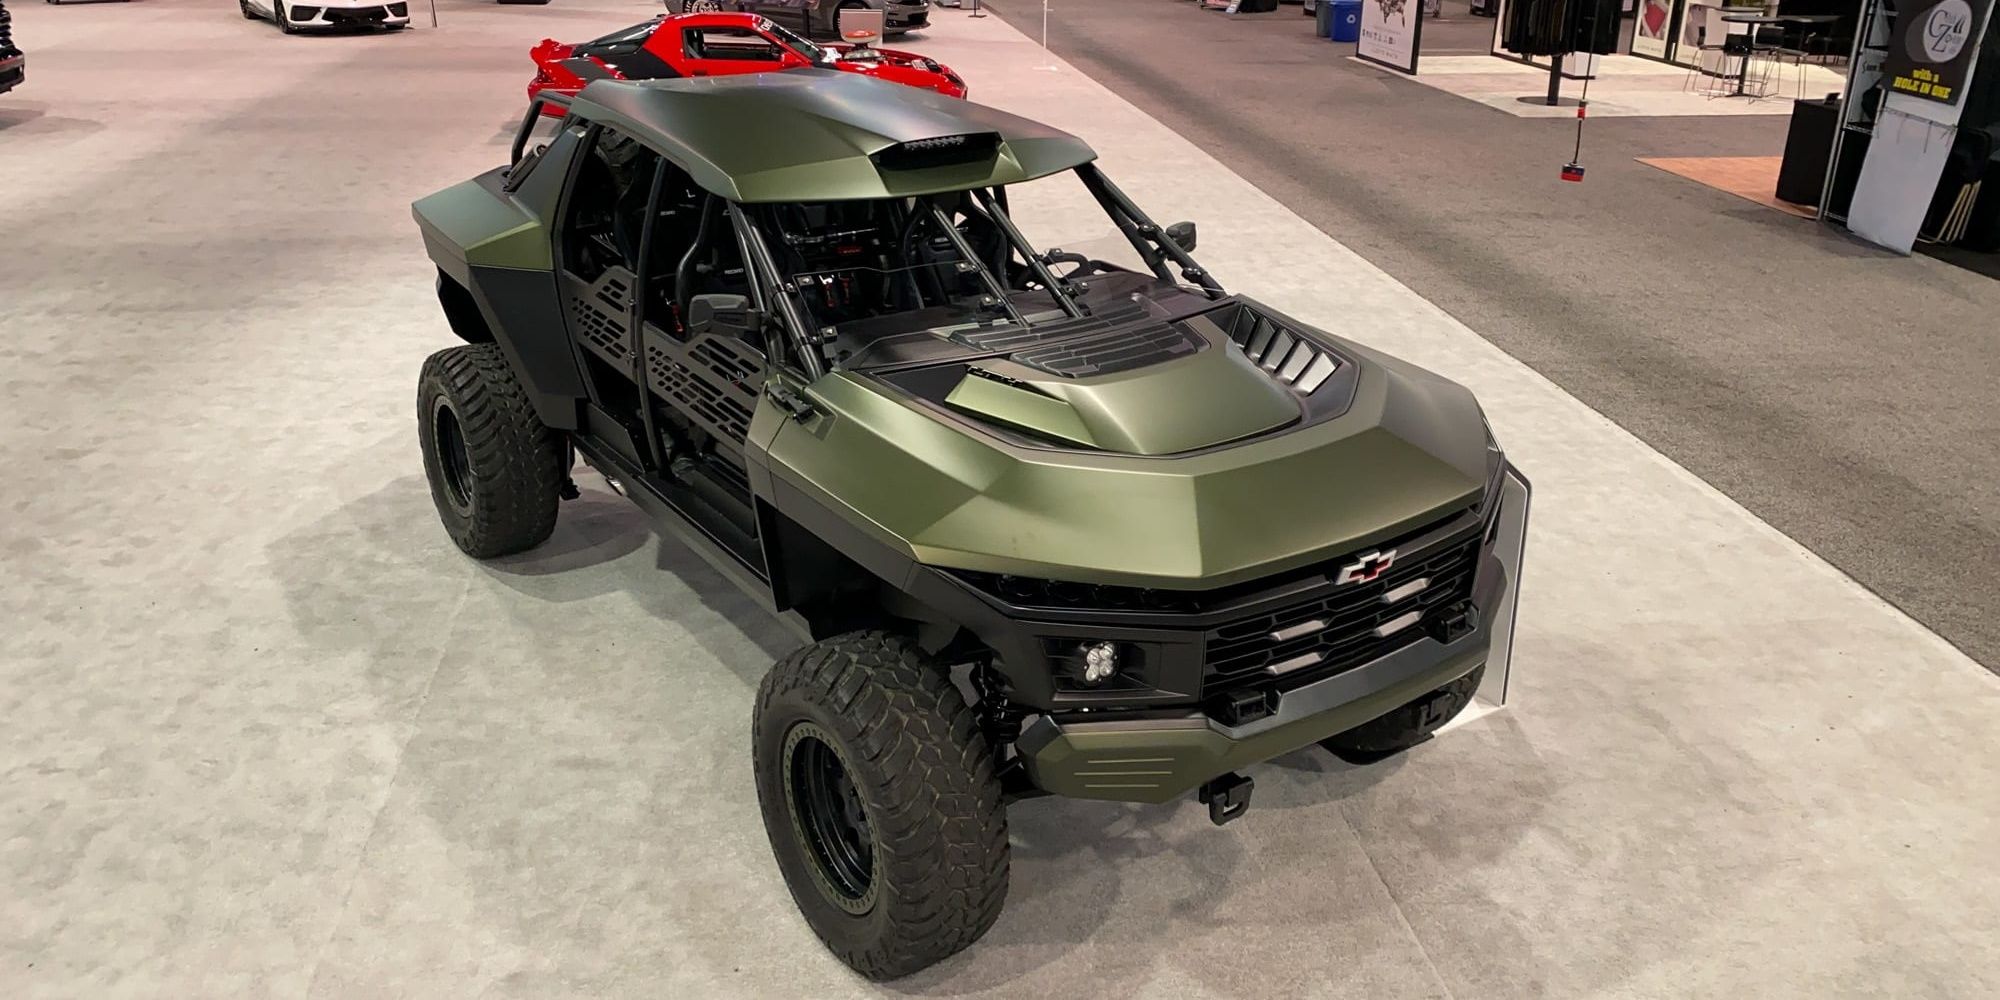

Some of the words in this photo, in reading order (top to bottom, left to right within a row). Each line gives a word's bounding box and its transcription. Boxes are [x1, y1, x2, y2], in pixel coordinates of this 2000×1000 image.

[1913, 69, 1932, 81] with
[1933, 74, 1939, 83] a
[1893, 76, 1920, 91] HOLE
[1920, 83, 1931, 94] IN
[1932, 85, 1952, 99] ONE
